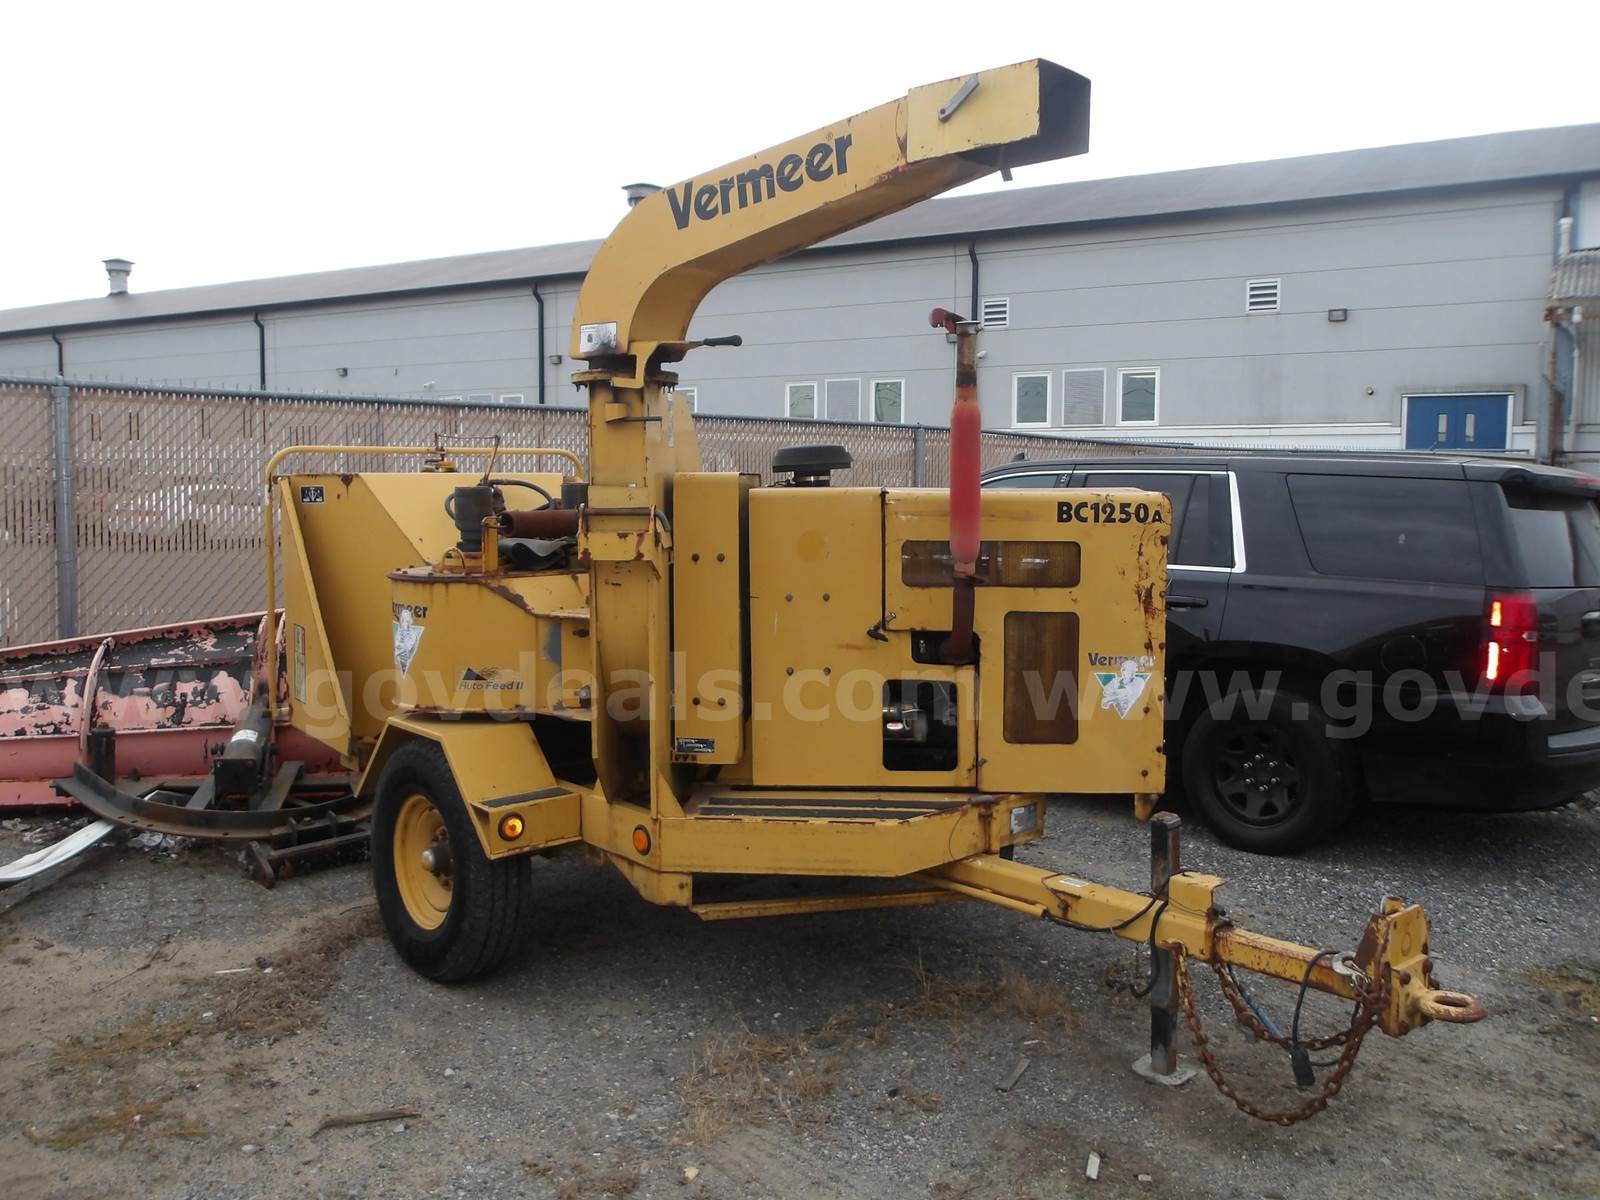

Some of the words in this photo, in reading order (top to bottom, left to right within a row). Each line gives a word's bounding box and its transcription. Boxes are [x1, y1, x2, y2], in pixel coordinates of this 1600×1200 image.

[666, 133, 853, 230] Vermeer
[1056, 501, 1163, 524] BC1250A
[485, 681, 514, 690] Feed
